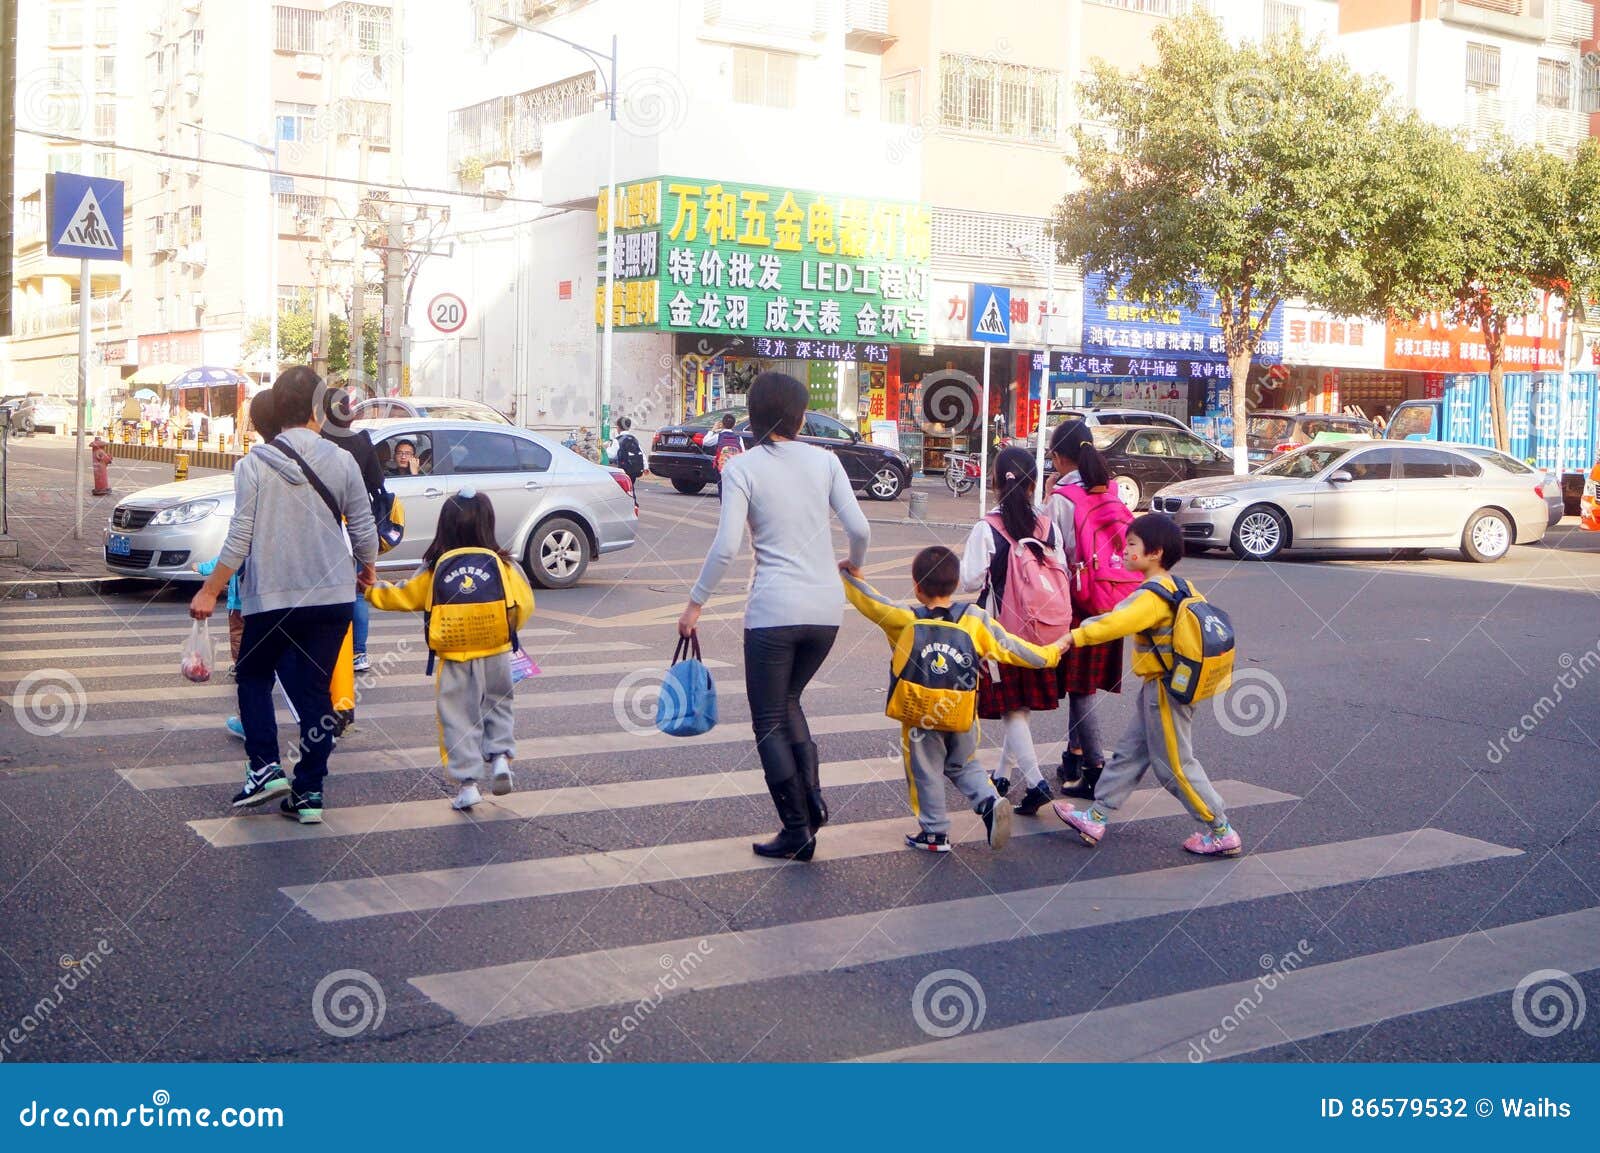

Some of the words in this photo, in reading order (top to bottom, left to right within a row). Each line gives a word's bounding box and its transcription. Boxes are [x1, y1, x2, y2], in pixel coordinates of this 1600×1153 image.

[669, 247, 782, 290] 特价批发
[436, 303, 459, 324] 20
[669, 290, 749, 329] 金龙羽
[765, 295, 842, 334] 成天泰
[856, 302, 929, 339] 金环宇
